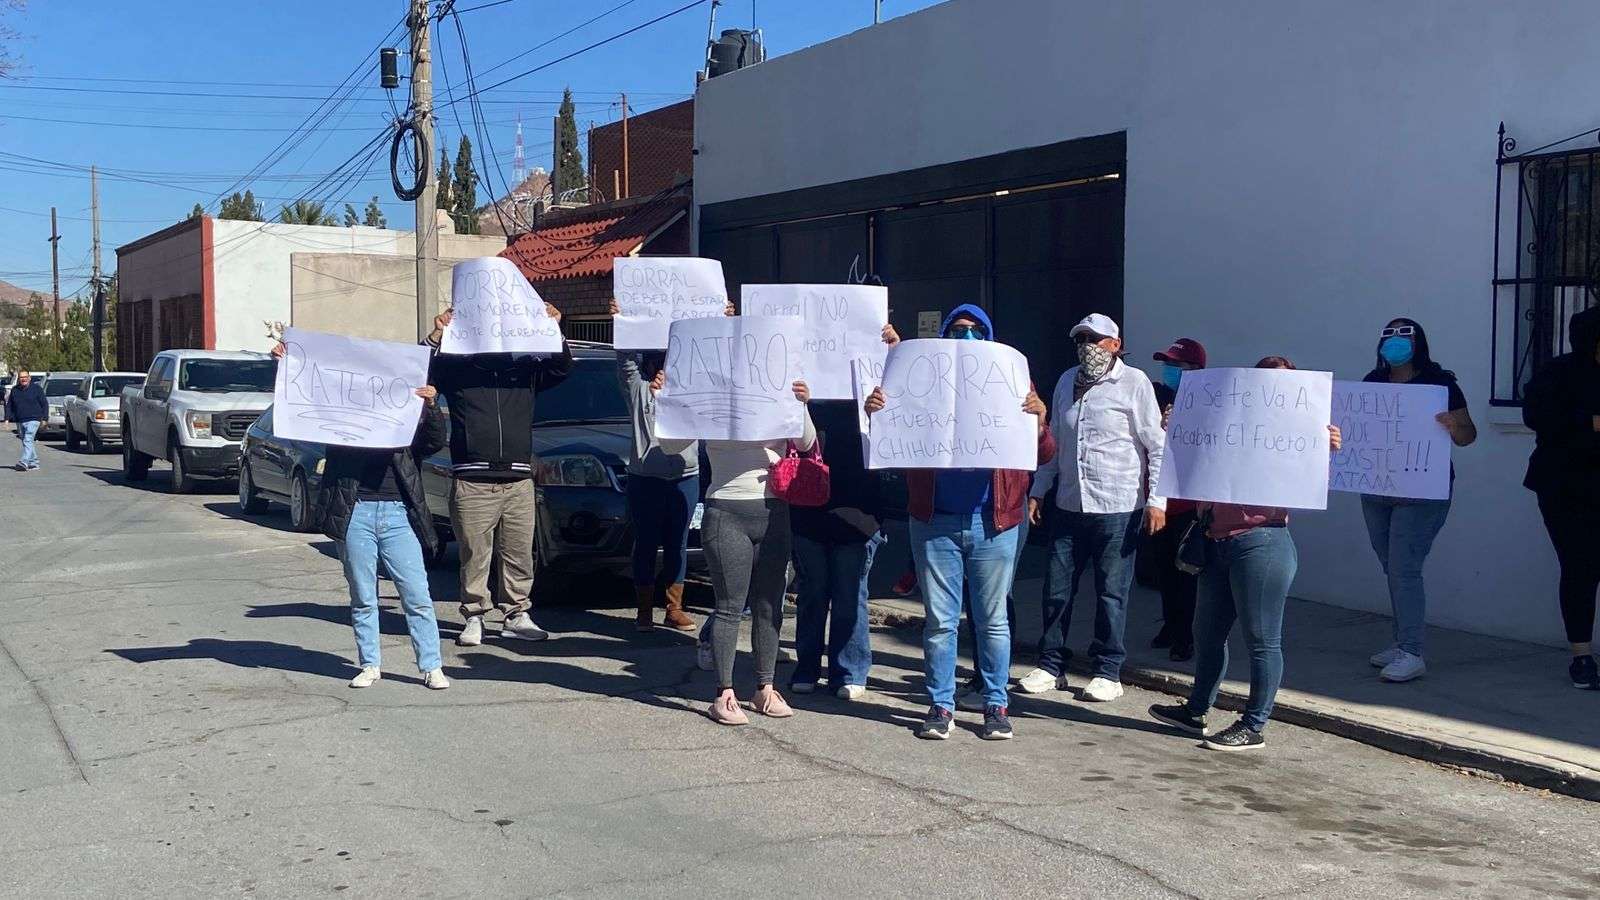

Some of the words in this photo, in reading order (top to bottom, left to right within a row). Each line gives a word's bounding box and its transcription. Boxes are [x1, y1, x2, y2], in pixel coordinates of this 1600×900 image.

[620, 264, 697, 288] CORRAL
[477, 301, 545, 319] MORENA
[648, 308, 665, 318] LA
[284, 340, 411, 409] RATERO
[666, 333, 788, 393] RATERO
[883, 351, 1028, 401] CORRAL
[1262, 383, 1286, 409] Va
[1294, 385, 1310, 412] A
[884, 404, 959, 428] FUERA
[978, 412, 1008, 429] DE
[1172, 422, 1218, 448] Acabar
[1225, 422, 1245, 448] El
[1377, 419, 1407, 444] TE
[876, 436, 999, 460] CHIHUAHUA
[1331, 447, 1397, 473] BASTE
